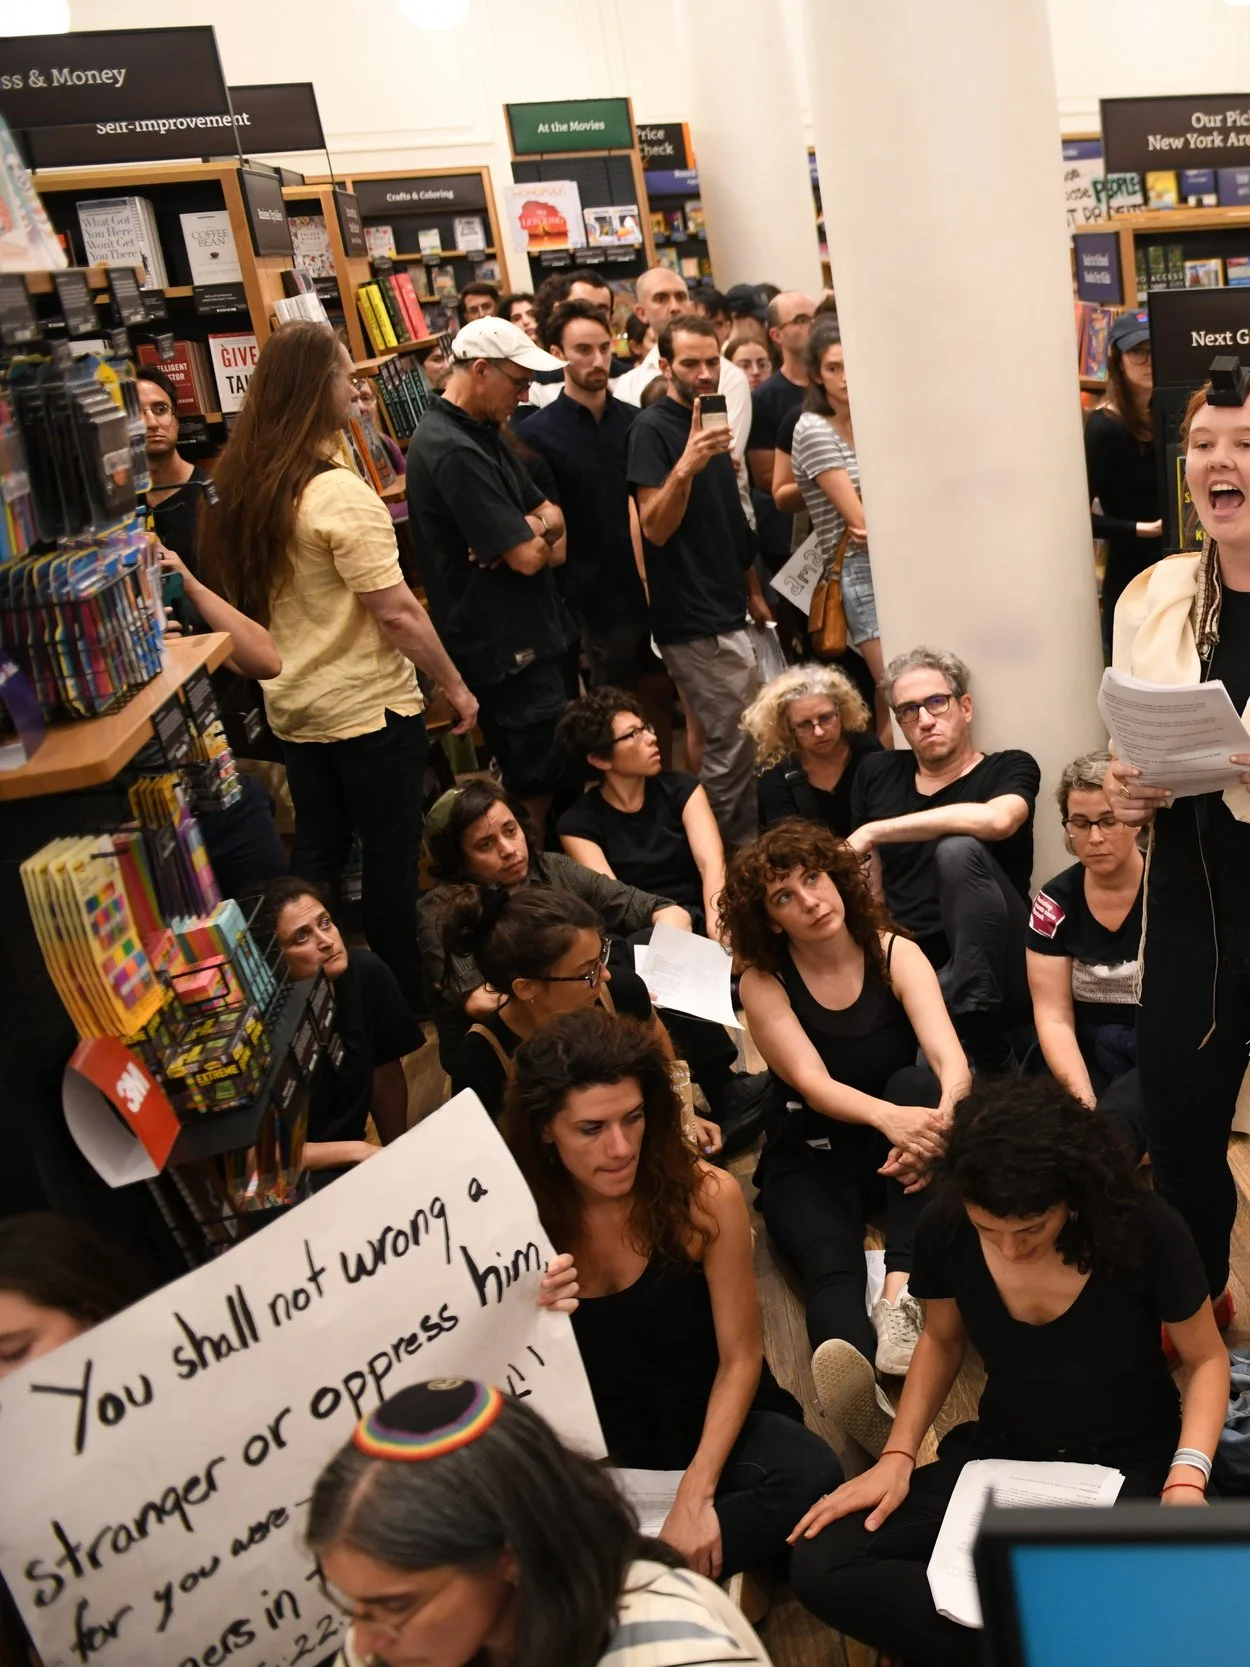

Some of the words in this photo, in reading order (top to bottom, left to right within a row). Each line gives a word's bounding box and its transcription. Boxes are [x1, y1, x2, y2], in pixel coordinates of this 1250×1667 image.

[0, 75, 23, 90] ss
[28, 69, 48, 88] &
[50, 68, 128, 88] Money
[537, 122, 550, 134] At
[551, 120, 568, 133] the
[569, 119, 606, 132] Movies
[1191, 112, 1224, 130] Our
[1148, 134, 1184, 151] New
[1185, 132, 1224, 149] York
[386, 191, 411, 202] Crafts
[411, 191, 418, 201] &
[419, 188, 455, 200] Coloring
[82, 215, 109, 228] What
[110, 215, 131, 227] Got
[84, 228, 104, 240] You
[106, 226, 133, 238] Here
[191, 228, 230, 240] COFFEE
[86, 238, 115, 250] Won't
[116, 237, 135, 249] Get
[198, 237, 227, 248] BEAN
[89, 250, 109, 262] You
[110, 249, 138, 261] There
[1150, 272, 1184, 282] ACCESS
[1191, 331, 1233, 347] Next
[221, 345, 258, 368] GIVE
[157, 363, 188, 373] ELLIGENT
[168, 372, 186, 381] STOR
[195, 1064, 241, 1086] EXTREME
[116, 1061, 151, 1114] 3M
[31, 1360, 153, 1455] You
[173, 1284, 262, 1381] shall
[269, 1239, 327, 1328] not
[340, 1196, 453, 1284] wrong
[467, 1177, 489, 1203] a
[24, 1457, 227, 1608] stranger
[242, 1406, 292, 1468] or
[309, 1302, 460, 1420] oppress
[70, 1598, 134, 1665] for
[154, 1556, 221, 1633] you
[230, 1506, 290, 1557] were
[260, 1589, 301, 1631] in
